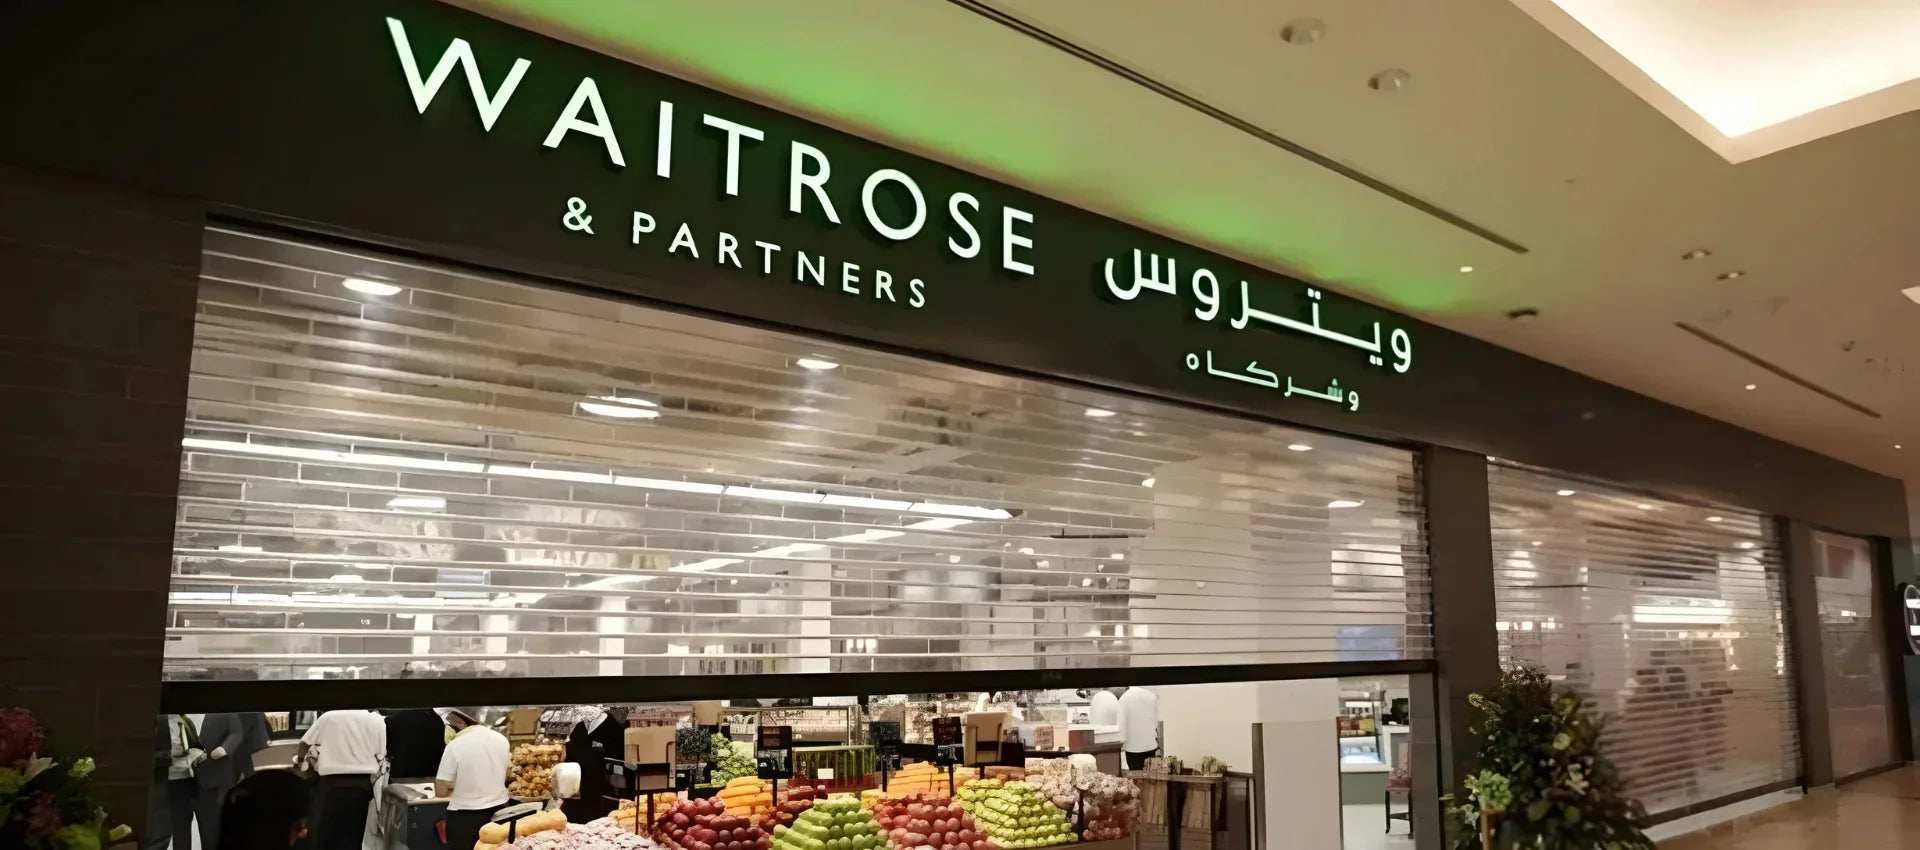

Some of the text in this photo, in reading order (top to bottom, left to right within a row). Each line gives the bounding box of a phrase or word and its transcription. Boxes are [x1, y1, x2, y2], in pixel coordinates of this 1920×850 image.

[386, 17, 1035, 275] WAITROSE
[562, 196, 926, 308] & PARTNERS
[1104, 247, 1412, 374] ويتروس
